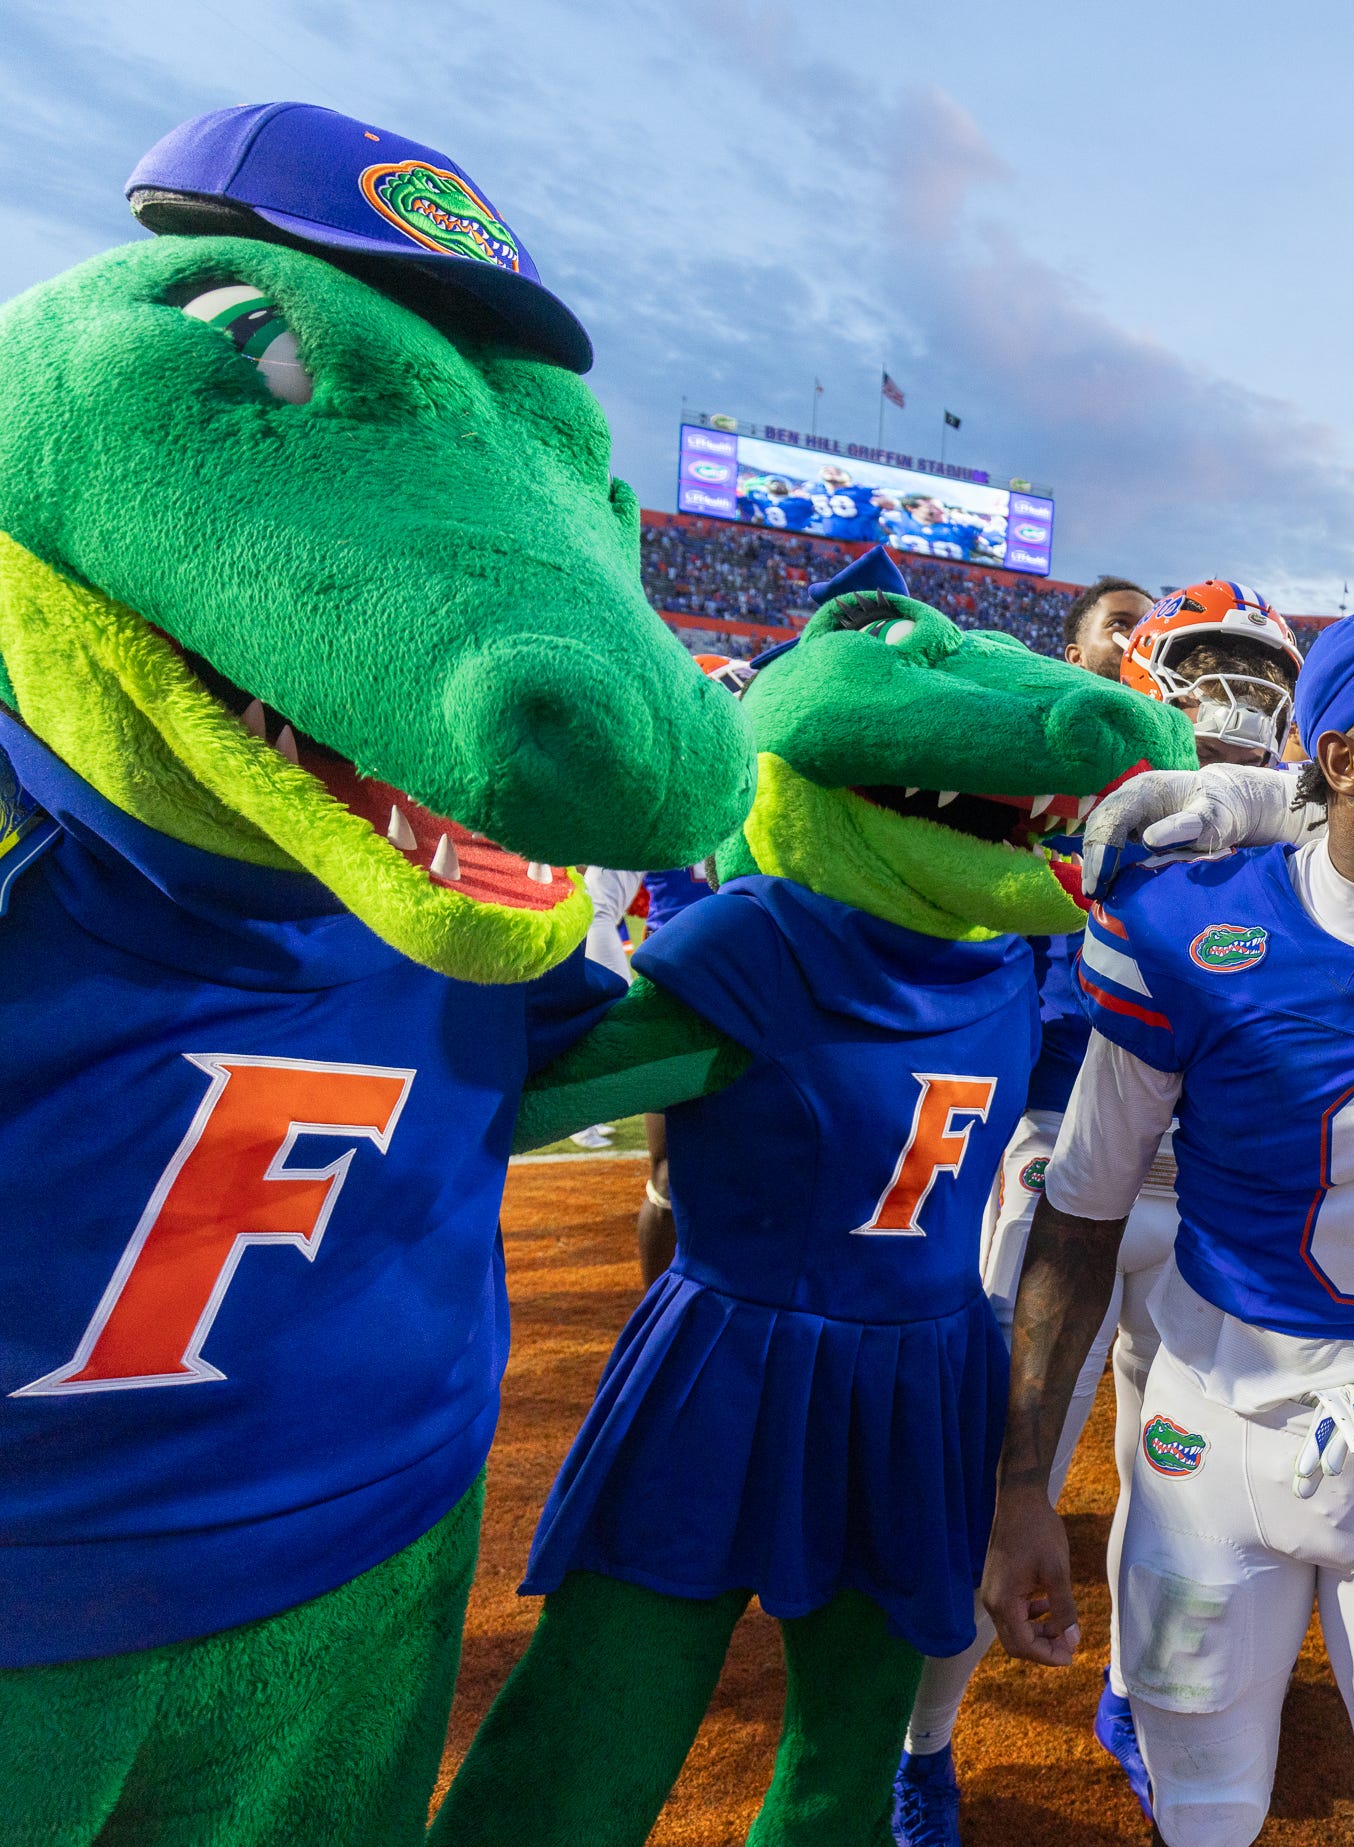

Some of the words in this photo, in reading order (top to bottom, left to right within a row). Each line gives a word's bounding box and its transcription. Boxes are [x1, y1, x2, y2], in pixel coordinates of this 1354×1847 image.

[765, 425, 799, 445] BEN
[806, 433, 840, 453] HILL
[848, 443, 912, 468] GRIFFIN
[918, 458, 989, 483] STADIUM
[7, 1053, 416, 1398] F
[849, 1072, 997, 1238] F
